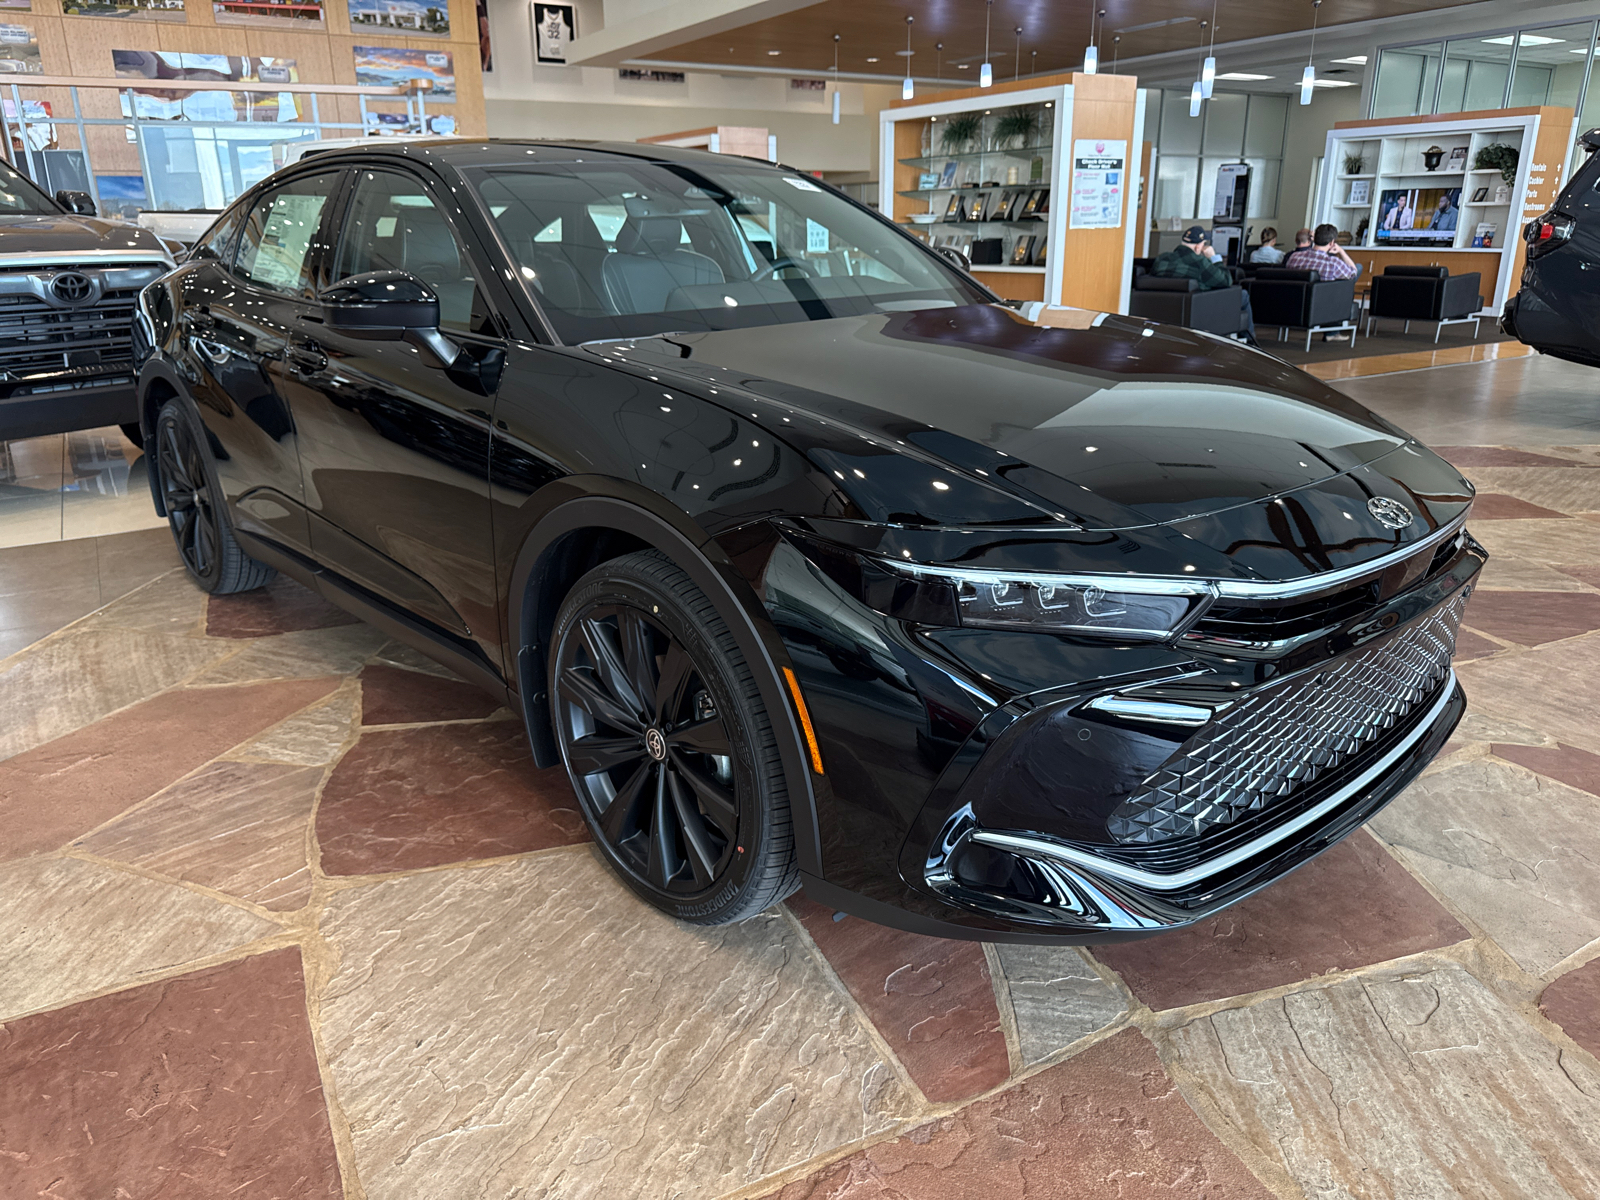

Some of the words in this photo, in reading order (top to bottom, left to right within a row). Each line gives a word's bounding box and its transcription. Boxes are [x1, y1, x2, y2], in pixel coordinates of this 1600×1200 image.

[547, 29, 561, 39] 32
[1526, 189, 1538, 198] Parts
[675, 878, 740, 917] BRIDGESTONE
